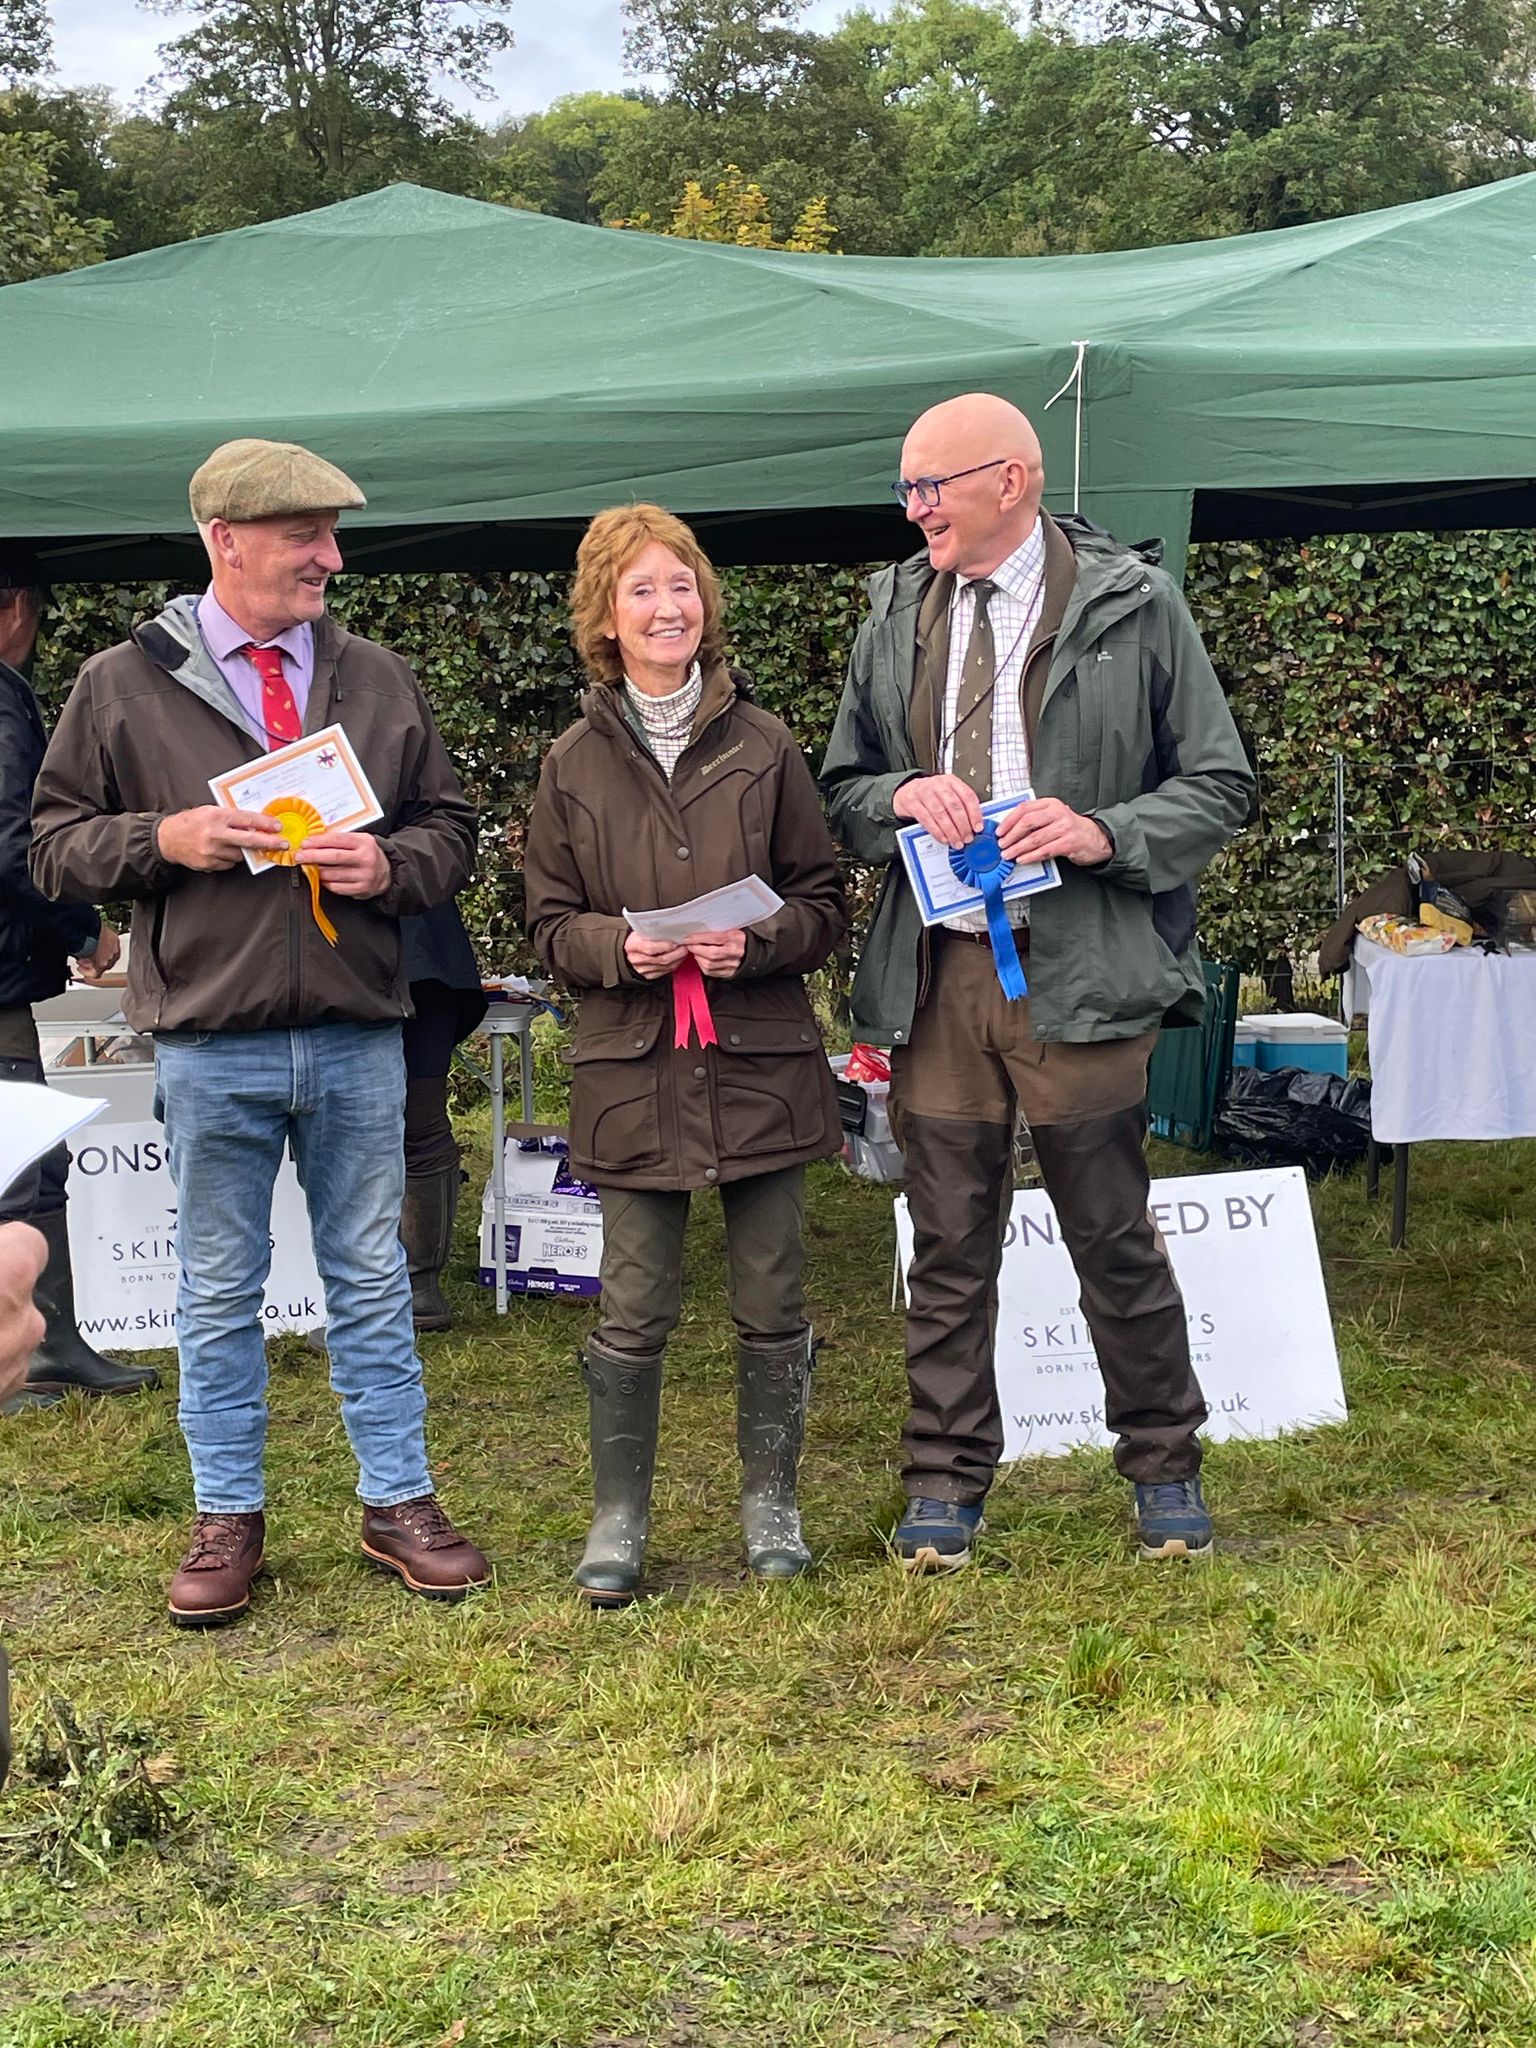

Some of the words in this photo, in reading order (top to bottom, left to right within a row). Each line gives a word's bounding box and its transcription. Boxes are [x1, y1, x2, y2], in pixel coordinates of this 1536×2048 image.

[1224, 1193, 1275, 1231] BY
[543, 1243, 587, 1260] HEROES
[121, 1274, 153, 1284] BORN
[161, 1272, 176, 1281] TO
[527, 1279, 555, 1290] HEROES
[1036, 1363, 1073, 1374] BORN
[1082, 1362, 1099, 1371] TO
